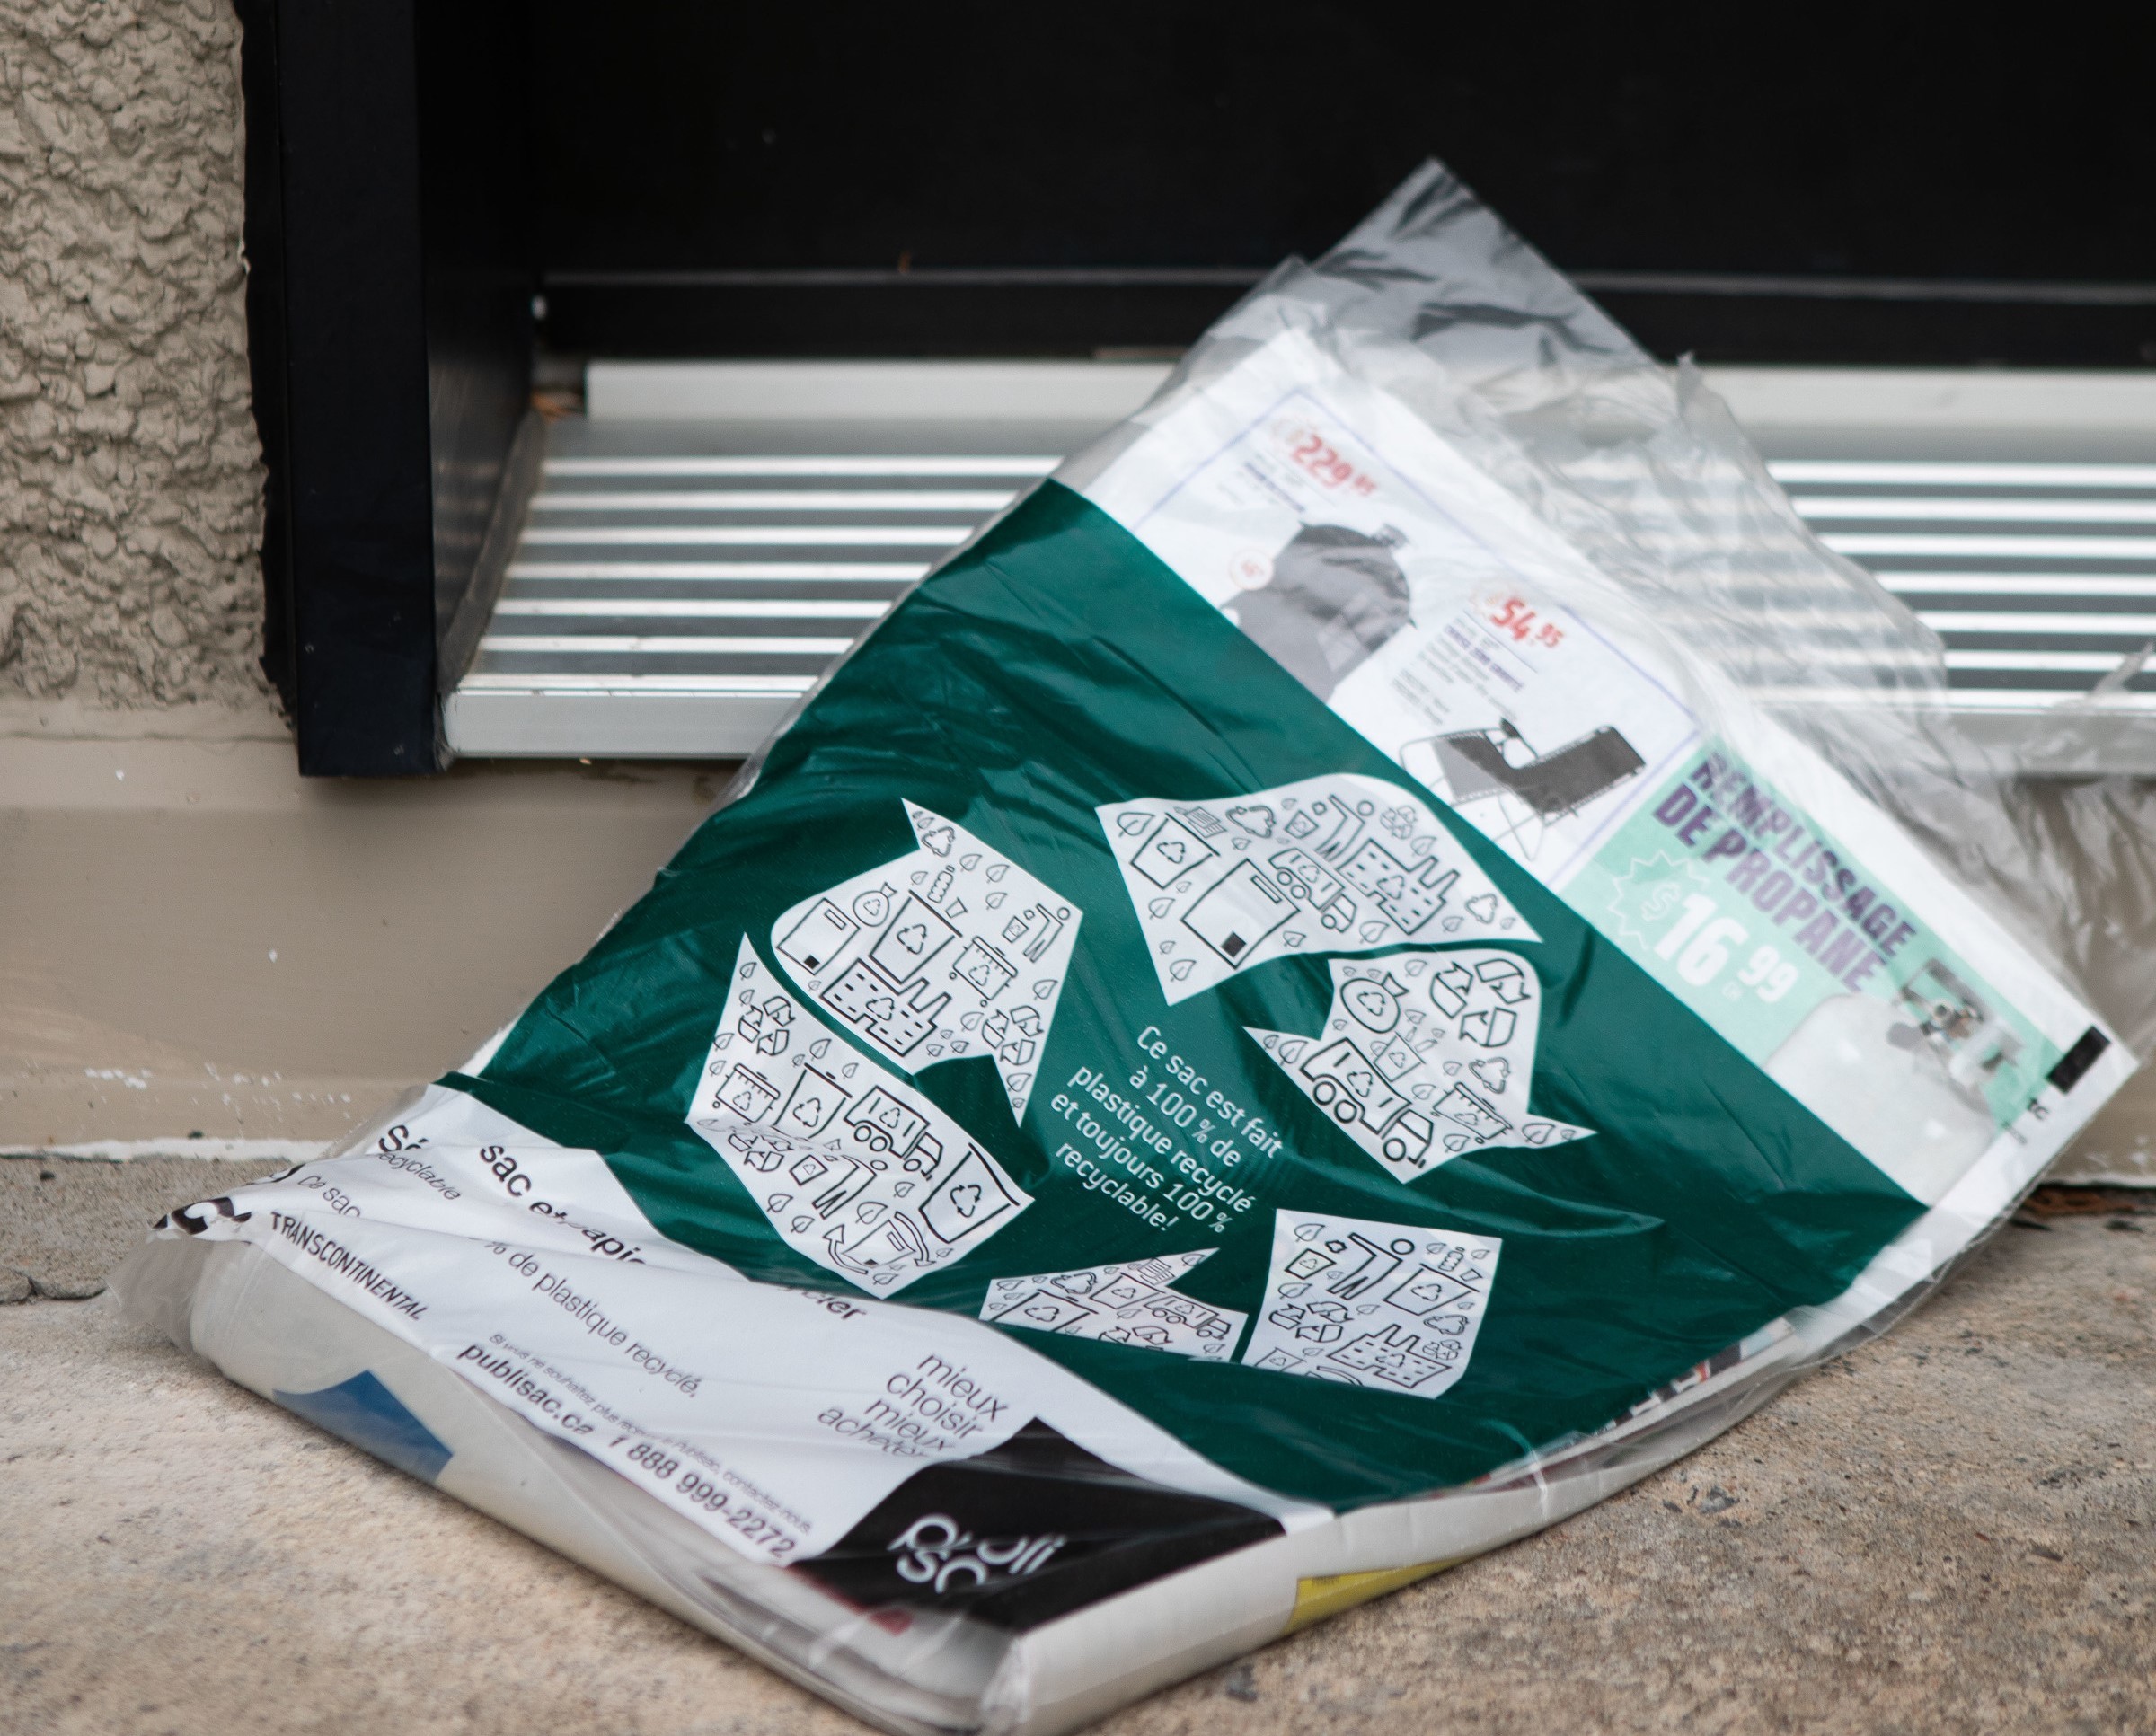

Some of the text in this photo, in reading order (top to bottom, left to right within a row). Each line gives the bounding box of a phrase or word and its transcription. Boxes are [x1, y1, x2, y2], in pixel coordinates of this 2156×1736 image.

[1653, 783, 1888, 992] DE PROPANE
[1690, 752, 1917, 956] REMPLISSAGE
[1067, 1066, 1257, 1212] plastique recyclé
[1129, 1065, 1241, 1168] à 100 % de
[1136, 1027, 1284, 1159] Ce sac est fait
[480, 1145, 532, 1197] sac
[1050, 1094, 1233, 1233] et toujours 100 %
[1056, 1142, 1180, 1232] recyclable!
[270, 1212, 429, 1322] TRANSCONTINENTAL
[298, 1175, 325, 1189] Ce
[508, 1252, 539, 1278] de
[532, 1273, 627, 1346] plastique
[543, 1364, 596, 1406] souhaitez
[592, 1403, 619, 1423] plus
[865, 1400, 955, 1451] mieux
[887, 1374, 983, 1439] choisir
[917, 1354, 1008, 1423] mieux
[457, 1344, 595, 1434] publisac.ca
[628, 1443, 678, 1479] 888
[676, 1473, 796, 1558] 999-2272
